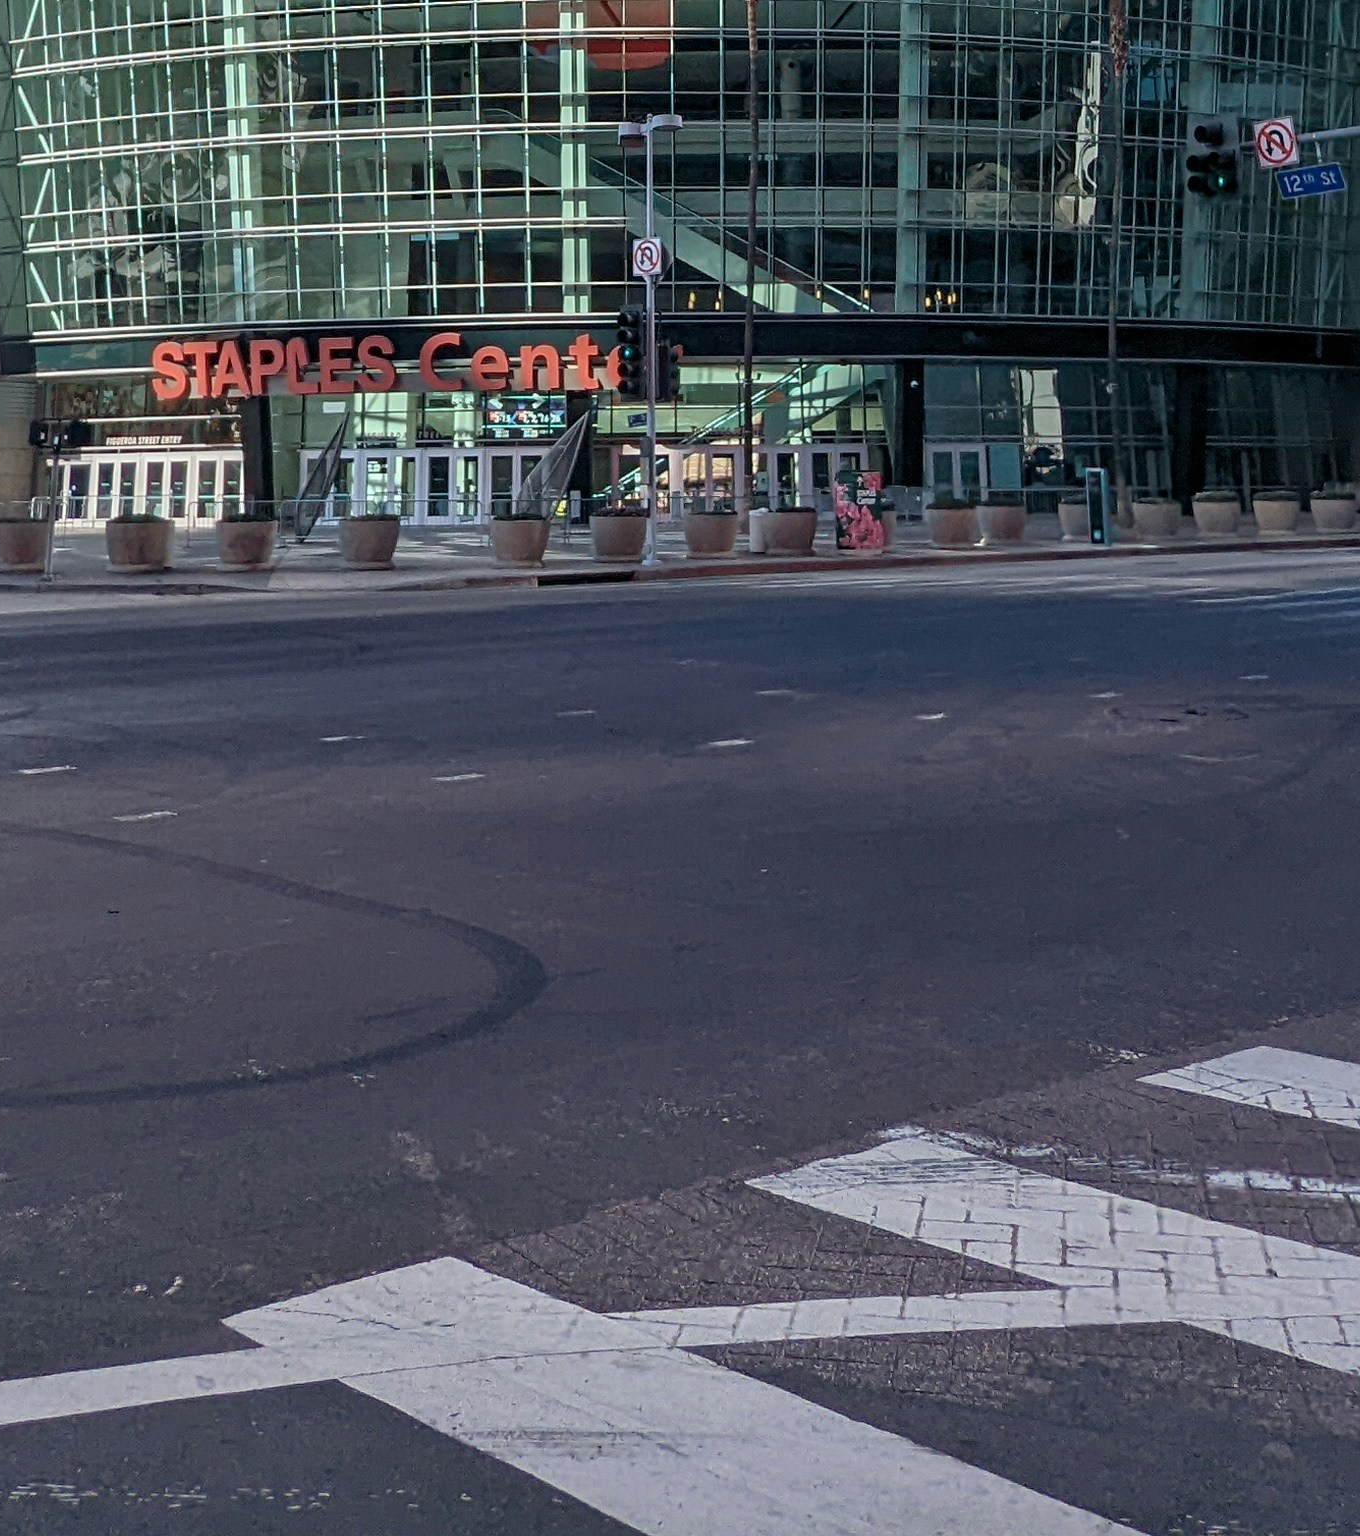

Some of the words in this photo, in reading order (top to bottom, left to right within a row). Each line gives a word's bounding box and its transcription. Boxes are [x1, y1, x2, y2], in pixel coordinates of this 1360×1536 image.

[1284, 173, 1315, 194] 12th
[1320, 171, 1337, 185] St
[152, 334, 396, 400] STAPLES
[419, 332, 683, 390] Cent
